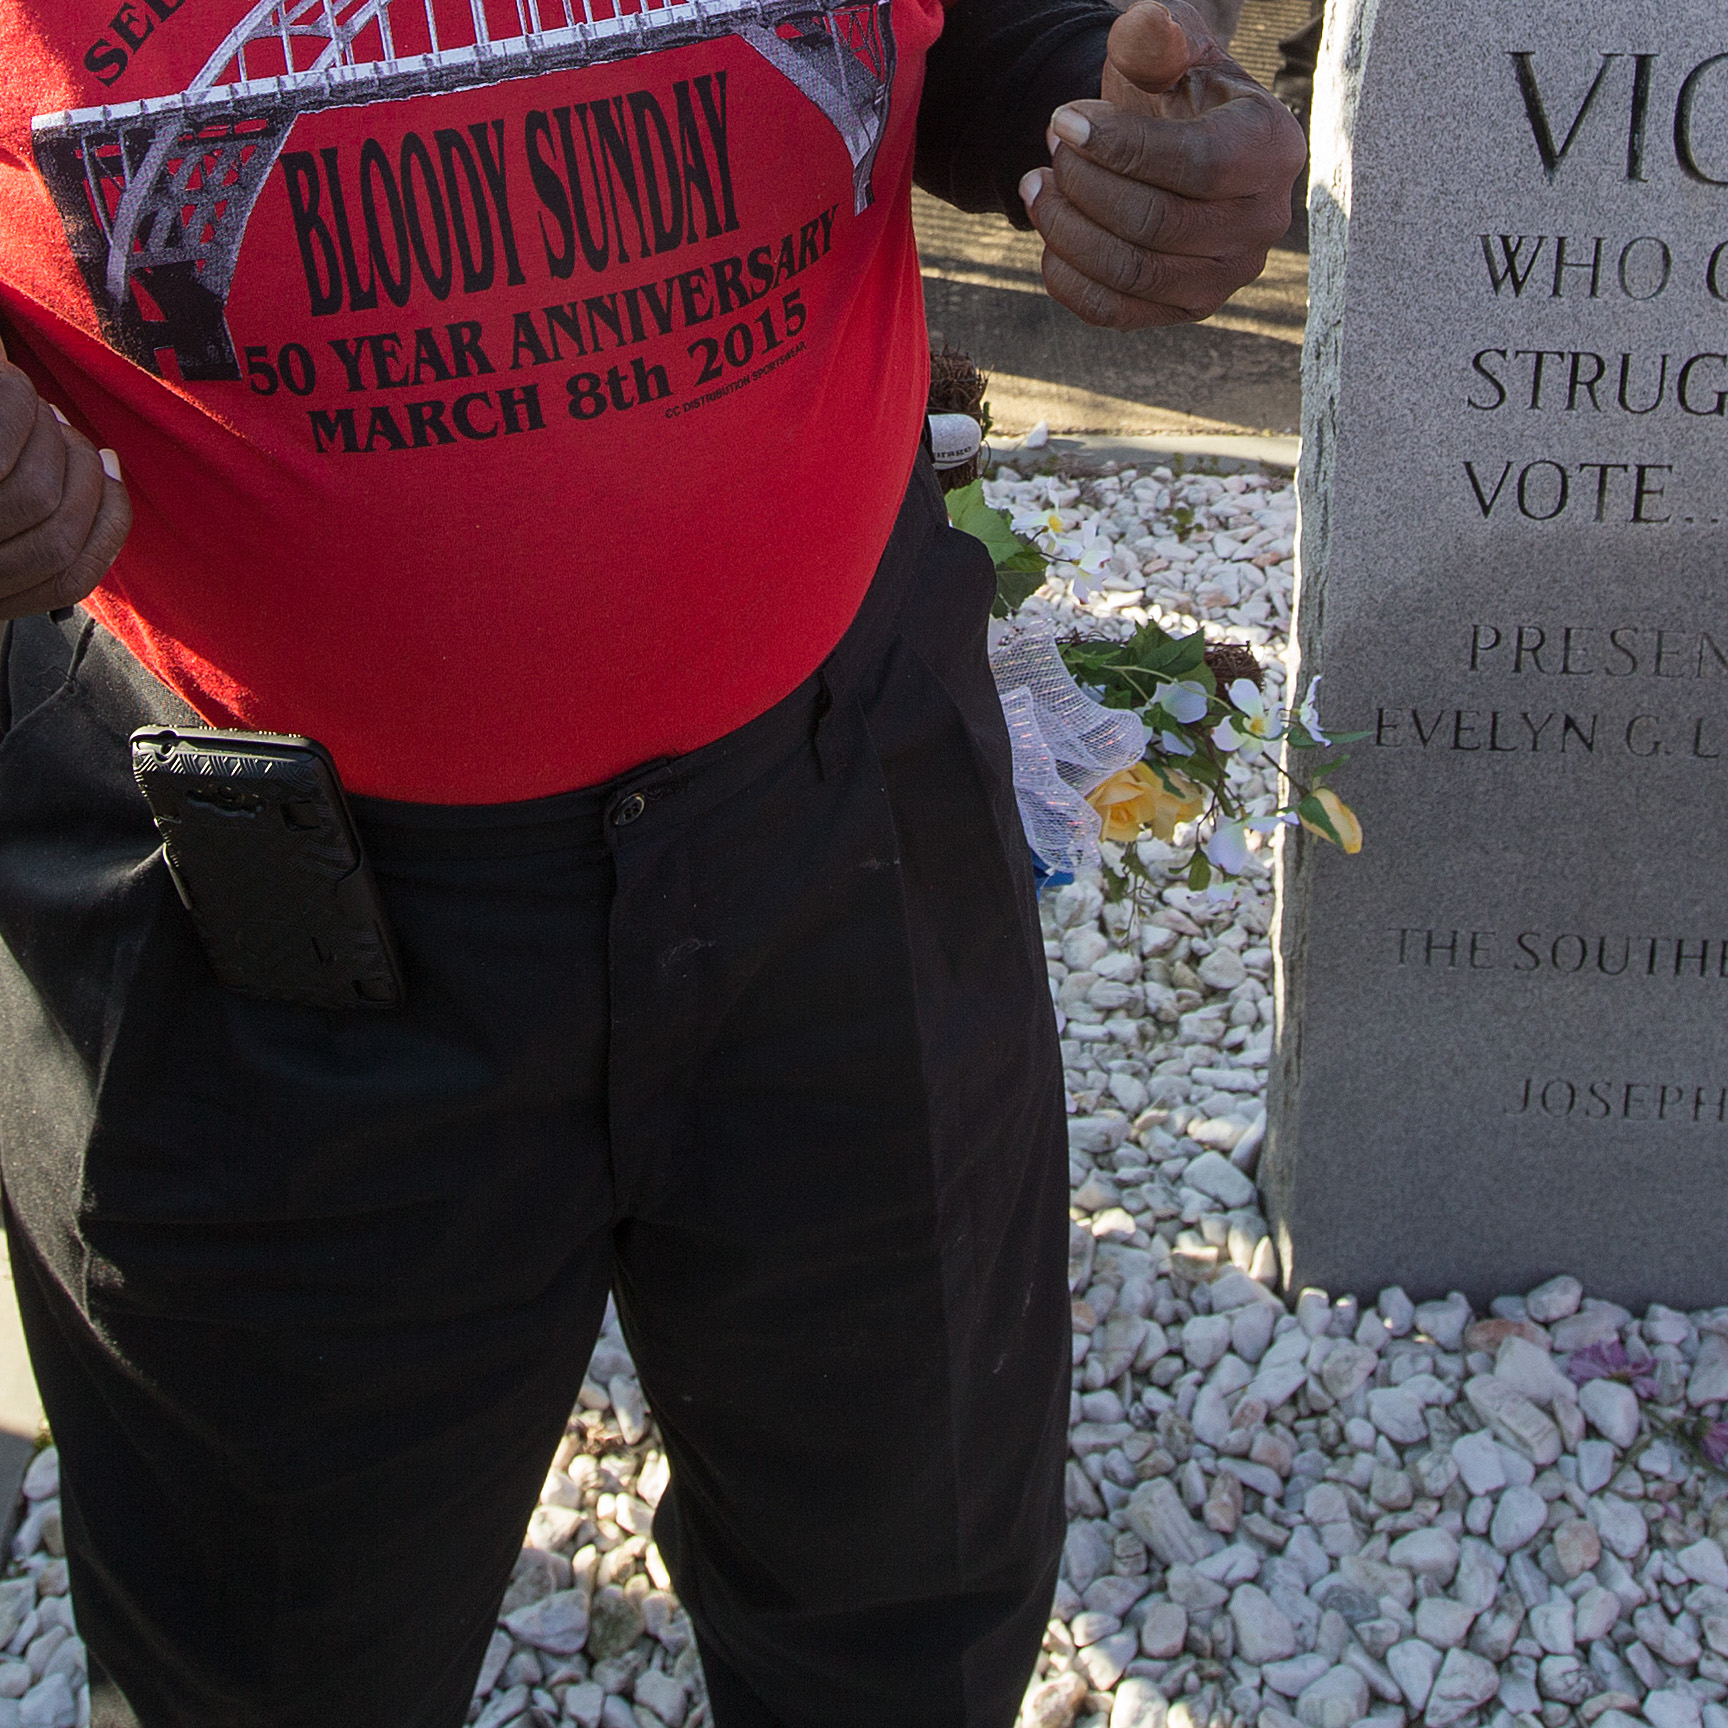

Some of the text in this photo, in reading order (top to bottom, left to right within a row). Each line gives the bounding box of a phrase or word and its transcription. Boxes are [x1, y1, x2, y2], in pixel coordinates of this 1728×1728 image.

[282, 70, 741, 319] BLOODY SUNDAY
[246, 204, 840, 396] 50 YEAR ANNIVERSARY
[1475, 232, 1673, 301] WHO
[309, 289, 808, 455] MARCH 8th 2015
[682, 373, 751, 414] DISTRIBUTION
[751, 340, 808, 383] SPORTSWEAR
[1373, 706, 1600, 755] EVELYN
[1386, 925, 1498, 971] THE
[1501, 1076, 1728, 1125] JOSEPH
